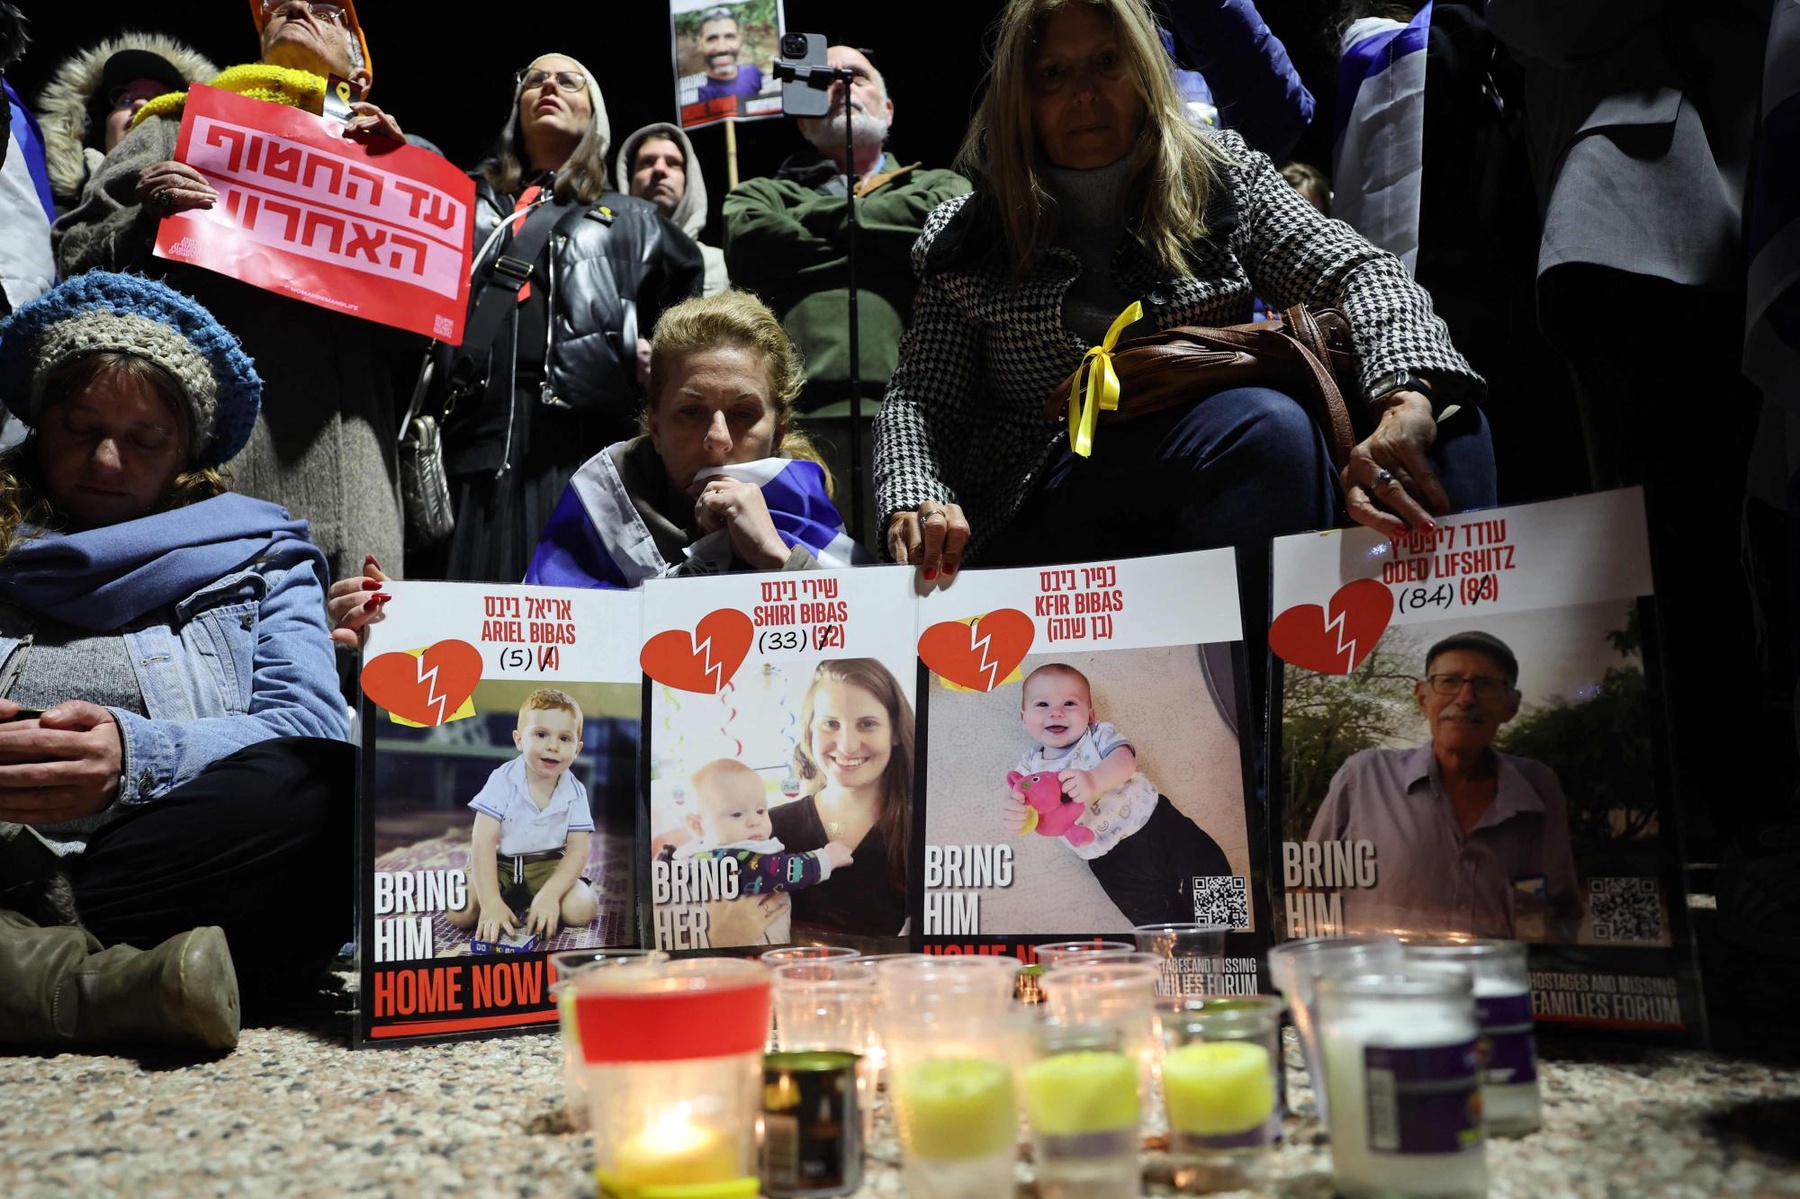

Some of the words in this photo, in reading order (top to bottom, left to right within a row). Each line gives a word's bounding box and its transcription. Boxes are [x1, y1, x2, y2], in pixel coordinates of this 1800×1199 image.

[206, 124, 384, 207] החטוף
[395, 181, 456, 230] עד
[1461, 518, 1507, 547] עודד
[1081, 565, 1116, 589] כפיר
[1382, 557, 1429, 585] ODED
[1435, 545, 1516, 579] LIFSHITZ
[761, 580, 797, 602] ביבס
[801, 578, 838, 599] שירי
[1040, 569, 1077, 592] ביבס
[484, 596, 521, 618] ביבס
[525, 596, 572, 620] אריאל
[1035, 594, 1070, 616] KFIR
[1074, 589, 1124, 615] BIBAS
[1399, 583, 1454, 614] (84)
[753, 604, 796, 627] SHIRI
[800, 600, 848, 624] BIBAS
[481, 620, 526, 643] ARIEL
[529, 622, 576, 645] BIBAS
[759, 629, 807, 654] (33)
[500, 647, 533, 671] (5)
[924, 843, 1014, 888] BRING
[1282, 839, 1377, 889] BRING
[374, 868, 467, 914] BRING
[652, 856, 740, 904] BRING
[653, 906, 710, 950] HER
[923, 892, 980, 935] HIM
[1285, 892, 1344, 939] HIM
[374, 917, 434, 963] HIM
[1191, 957, 1211, 974] AND
[374, 966, 464, 1017] HOME
[1207, 974, 1258, 996] FORUM
[1529, 971, 1589, 991] HOSTAGES
[1591, 974, 1616, 993] AND
[1618, 975, 1677, 996] MISSING
[1531, 989, 1609, 1019] FAMILIES
[1613, 994, 1682, 1024] FORUM
